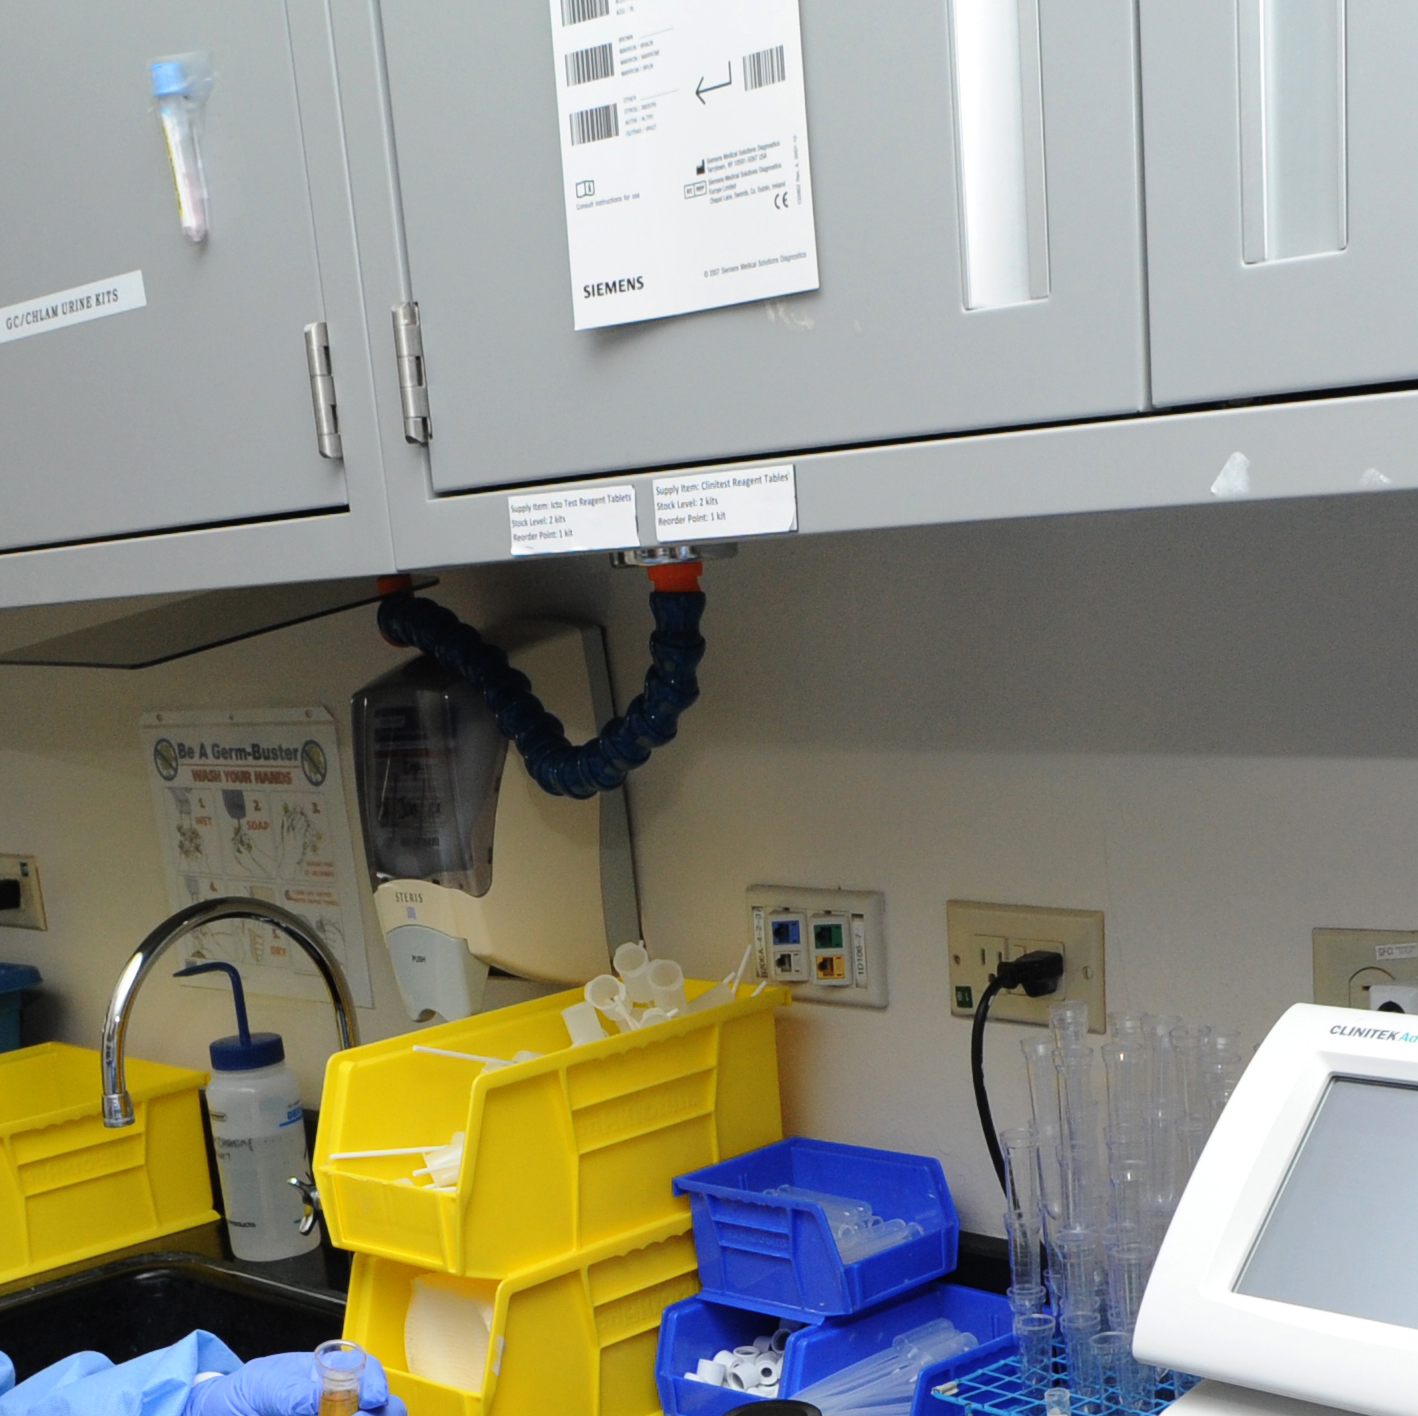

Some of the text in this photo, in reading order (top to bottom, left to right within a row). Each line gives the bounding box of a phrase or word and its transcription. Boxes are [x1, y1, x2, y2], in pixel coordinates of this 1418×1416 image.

[583, 276, 645, 299] SIEMENS
[6, 288, 119, 331] GC/CHLAM URINE KITS
[656, 484, 680, 497] Supply
[701, 478, 731, 491] Clinitest
[732, 477, 763, 490] Reagent
[564, 498, 578, 508] Test
[579, 496, 606, 508] Reagent
[607, 492, 632, 504] Tablets
[657, 500, 678, 511] Stock
[704, 496, 719, 507] kits
[511, 518, 529, 528] Stock
[554, 514, 567, 525] kits
[658, 515, 686, 527] Reorder
[716, 510, 727, 521] kit
[513, 530, 538, 542] Reorder
[564, 528, 574, 538] kit
[177, 742, 300, 761] Be A Germ-Buster
[191, 769, 293, 785] WASH YOUR HANDS
[246, 820, 271, 831] SOAP
[395, 891, 424, 904] STERIS
[1329, 1024, 1400, 1042] CLINITEK
